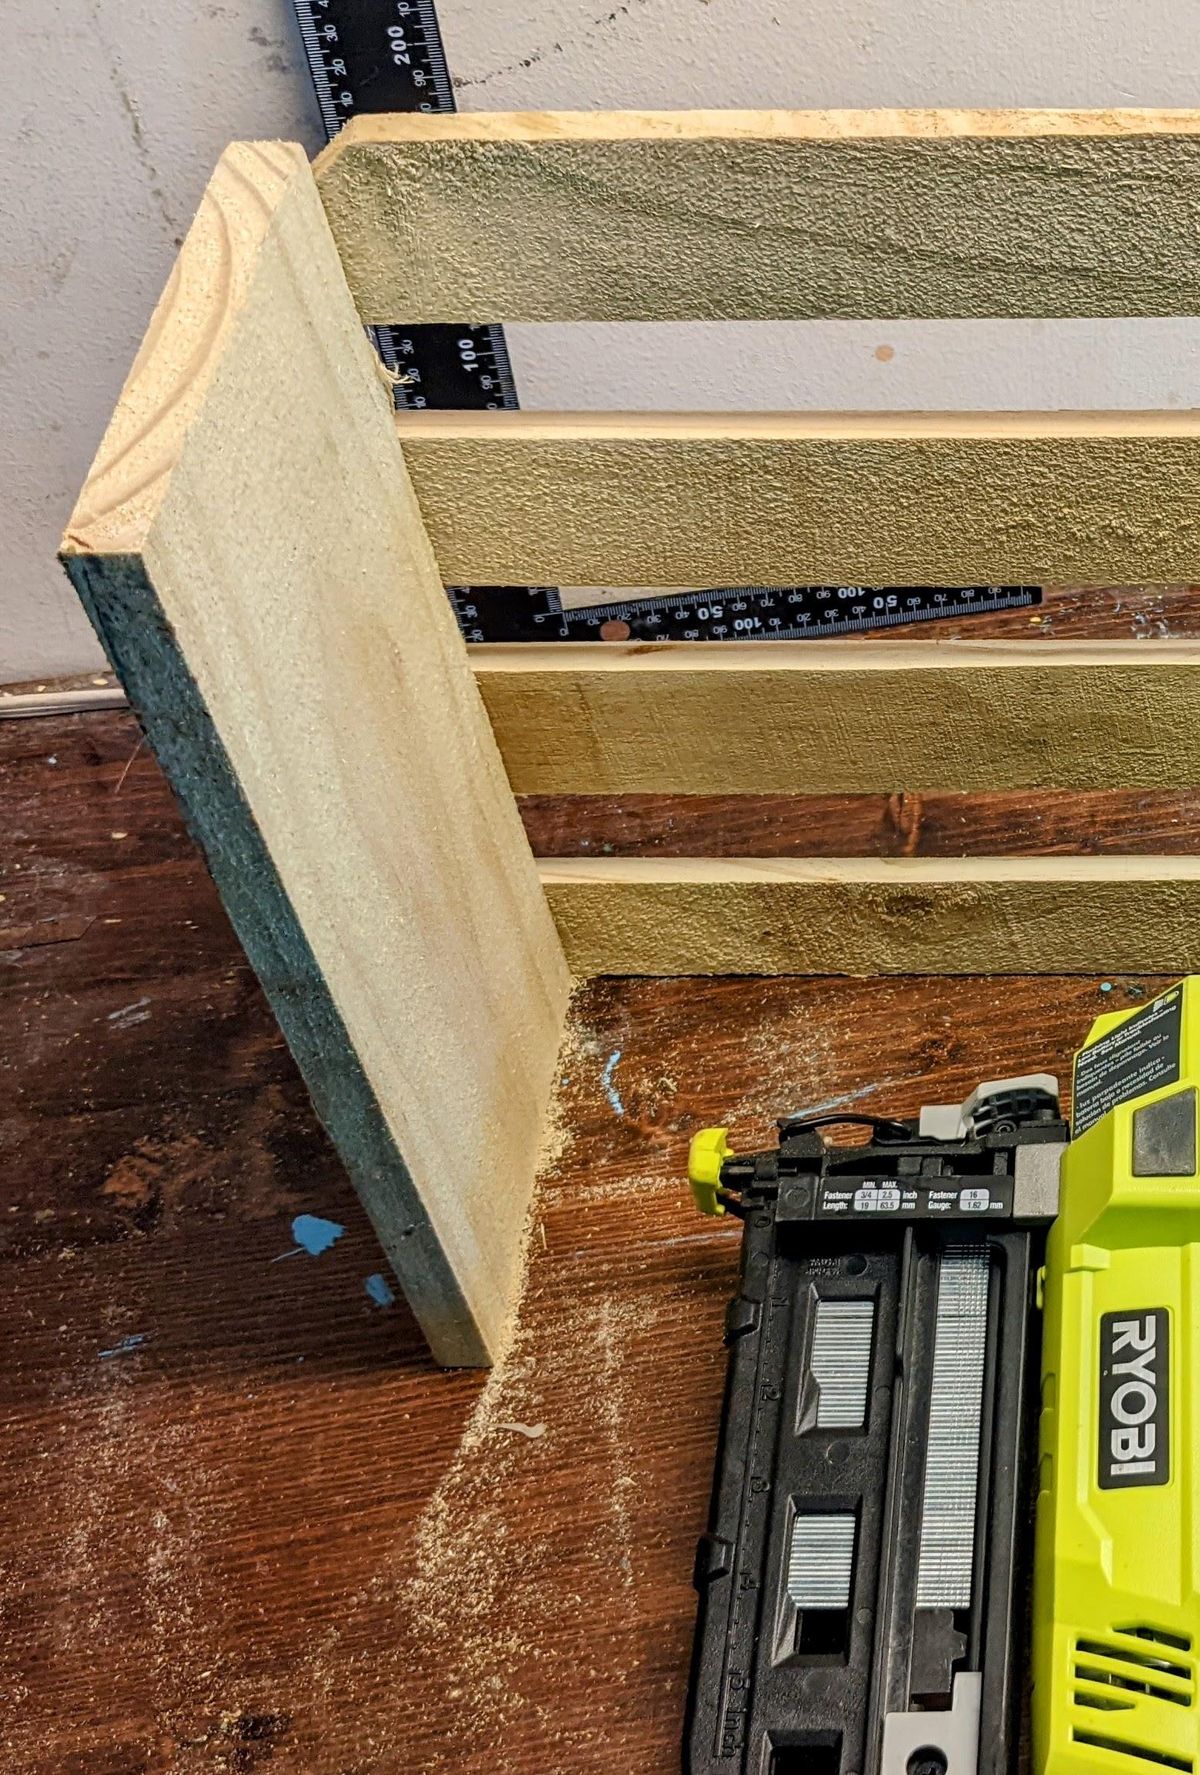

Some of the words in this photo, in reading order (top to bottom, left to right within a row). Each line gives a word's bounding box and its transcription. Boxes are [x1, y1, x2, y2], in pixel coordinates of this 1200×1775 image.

[397, 2, 411, 18] 10
[324, 24, 339, 42] 30
[387, 25, 411, 65] 200
[332, 58, 347, 76] 20
[412, 70, 427, 87] 90
[401, 339, 415, 355] 30
[458, 339, 479, 372] 100
[480, 375, 494, 390] 90
[647, 615, 662, 624] 30
[675, 611, 690, 620] 40
[697, 605, 723, 620] 50
[731, 602, 747, 612] 60
[760, 598, 776, 608] 70
[788, 594, 804, 603] 80
[816, 589, 831, 600] 90
[837, 587, 866, 599] 100
[684, 629, 699, 639] 80
[713, 625, 728, 635] 90
[735, 616, 762, 630] 100
[768, 617, 782, 626] 10
[796, 613, 811, 622] 20
[824, 609, 839, 618] 30
[852, 605, 867, 614] 40
[873, 594, 898, 609] 50
[906, 597, 921, 606] 60
[933, 593, 948, 603] 70
[960, 589, 975, 598] 80
[824, 1191, 853, 1200] Fastener
[860, 1191, 872, 1199] 3/4
[882, 1191, 893, 1199] 2.5
[902, 1191, 918, 1199] inch
[928, 1191, 958, 1200] Fastener
[969, 1191, 978, 1199] 16
[822, 1201, 848, 1211] Length:
[880, 1201, 895, 1210] 63.5
[928, 1201, 952, 1210] Gauge:
[967, 1201, 982, 1210] 1.62
[1111, 1315, 1157, 1476] RYOBI
